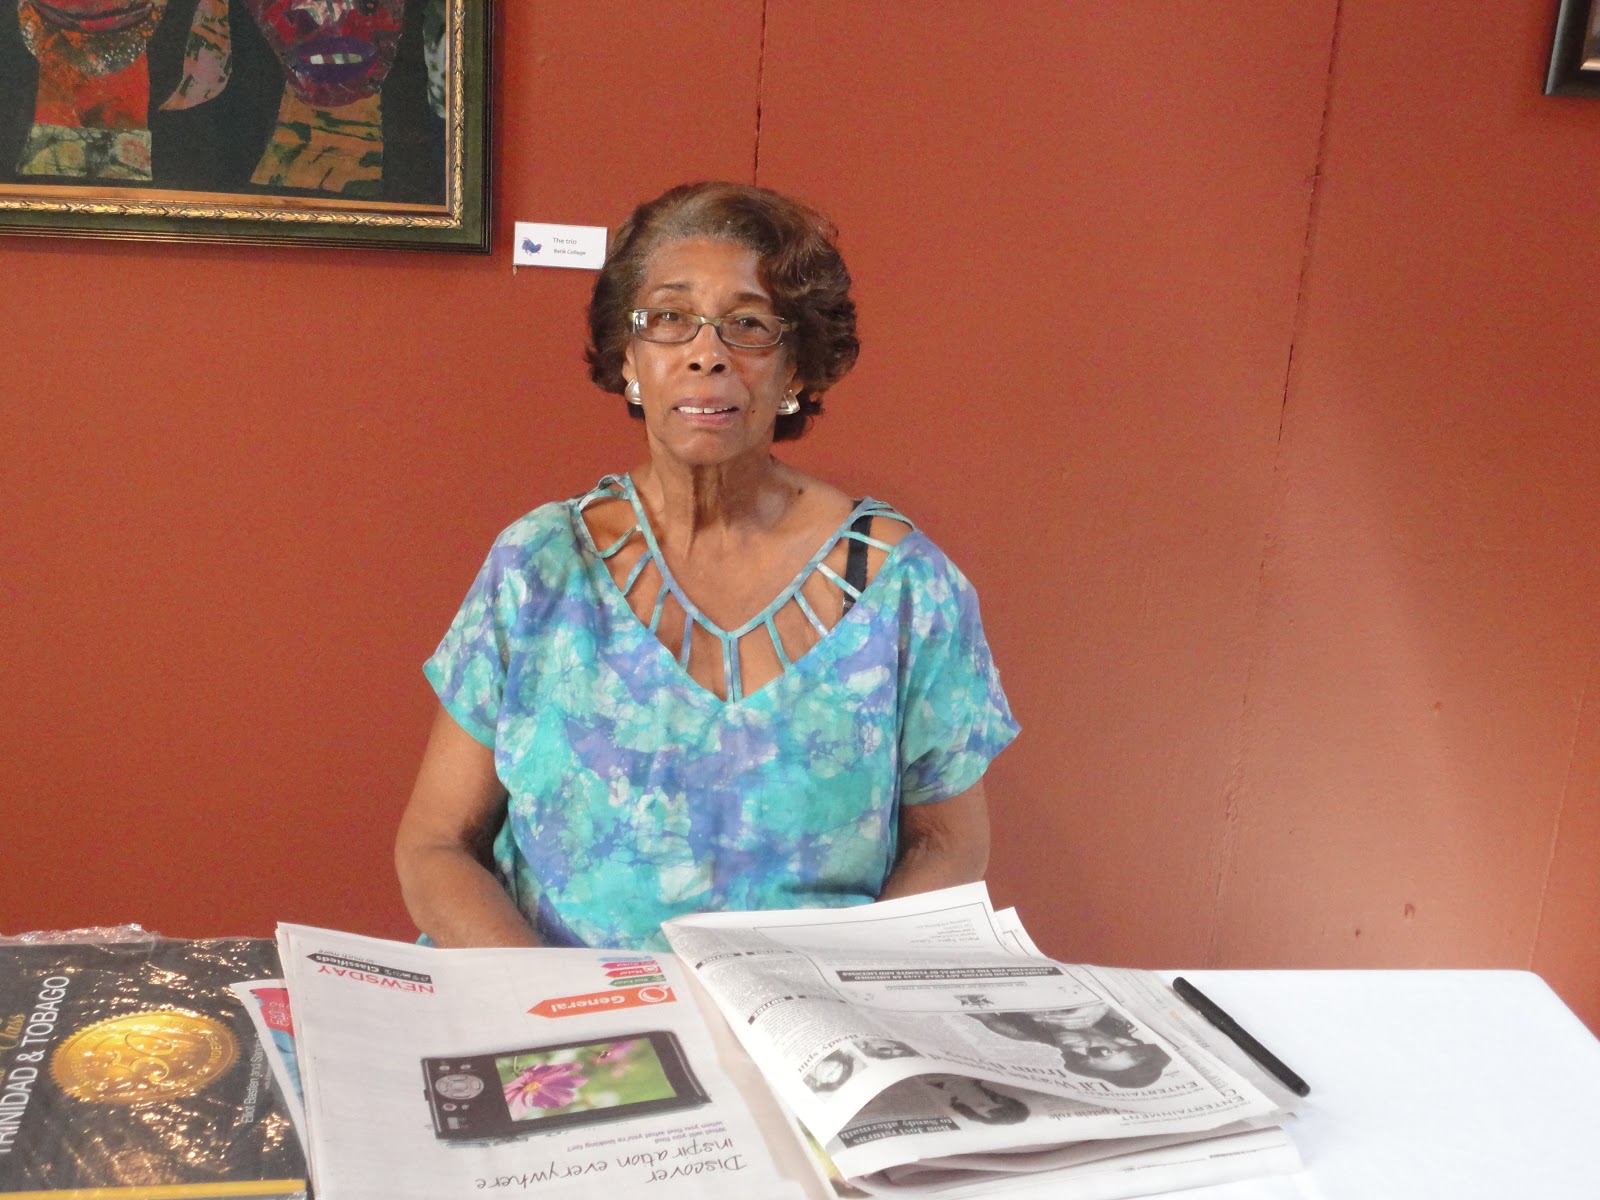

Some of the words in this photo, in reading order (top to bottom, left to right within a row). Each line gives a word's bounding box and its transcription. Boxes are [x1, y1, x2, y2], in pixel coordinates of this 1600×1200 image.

[315, 955, 380, 973] Classifieds
[318, 965, 434, 994] NEWSDAY
[20, 976, 70, 1047] TOBAGO
[550, 995, 626, 1013] General
[16, 1048, 46, 1062] &
[250, 1064, 261, 1077] and
[243, 1078, 259, 1105] Bastien
[1048, 1112, 1071, 1121] role
[1120, 1096, 1245, 1121] ENTERTAINMENT
[840, 1121, 899, 1139] aftermath
[853, 1129, 897, 1144] returns
[616, 1138, 733, 1170] inspiration
[475, 1162, 608, 1190] everywhere
[645, 1155, 747, 1184] Discover
